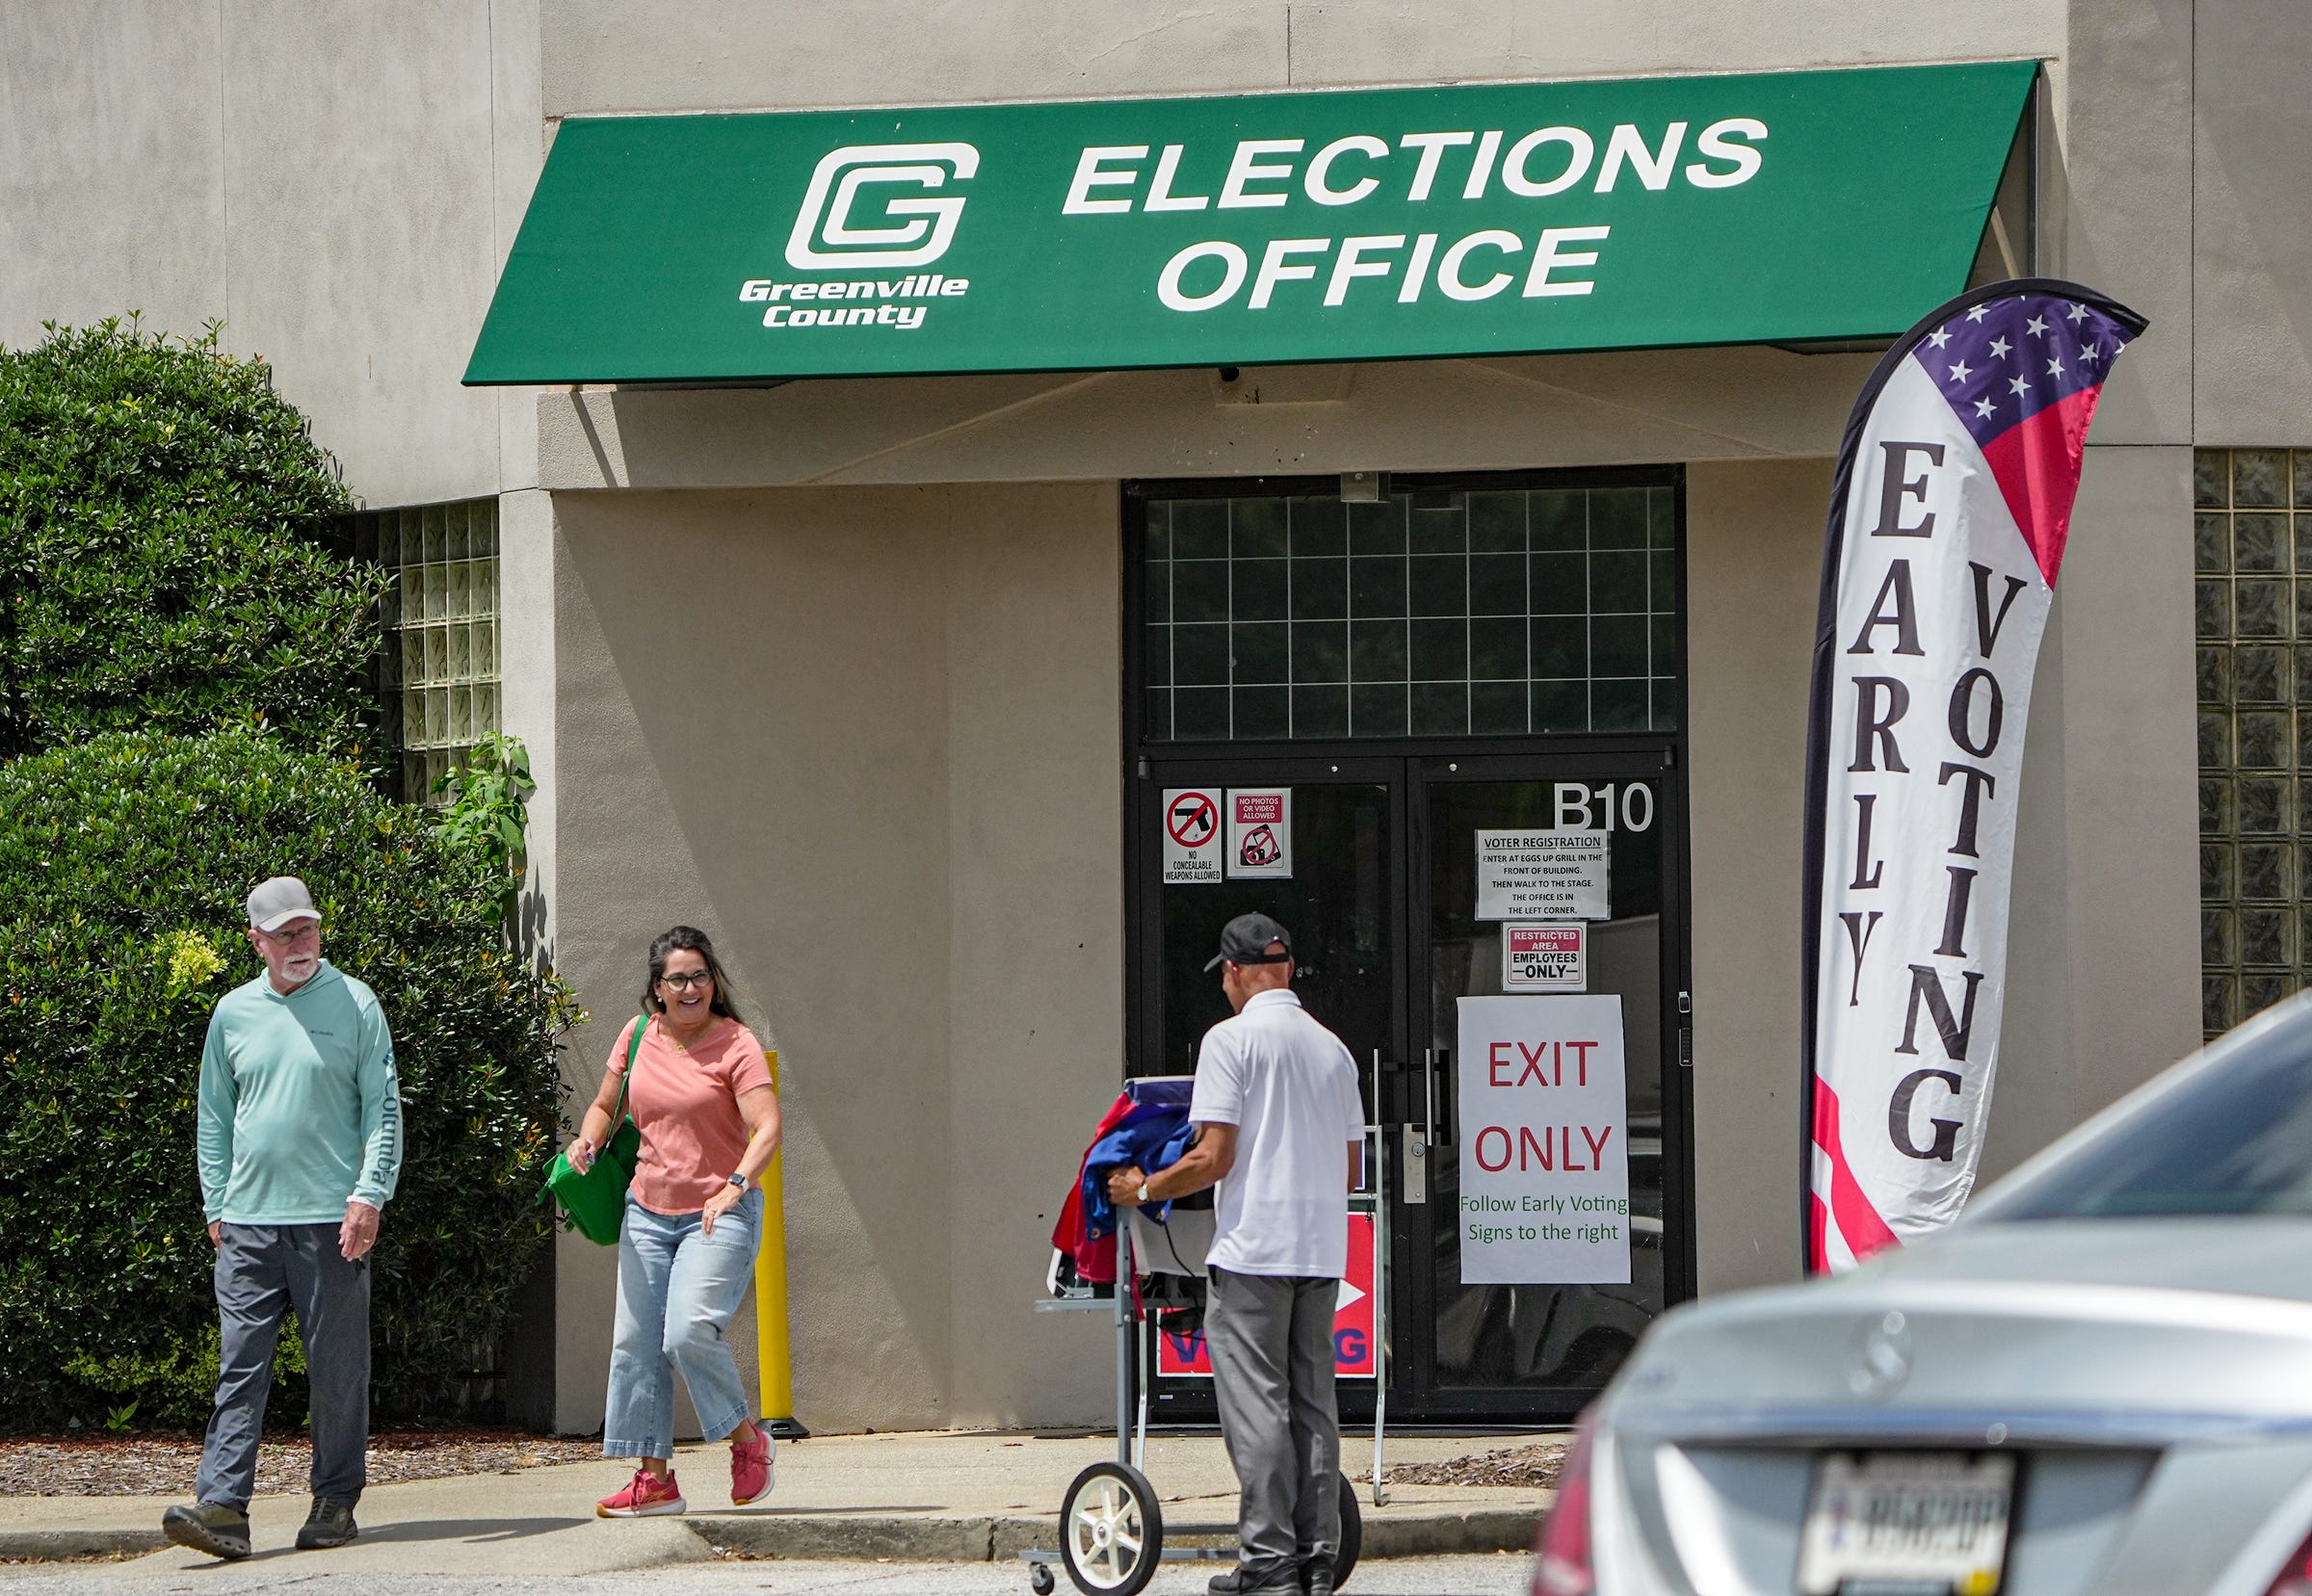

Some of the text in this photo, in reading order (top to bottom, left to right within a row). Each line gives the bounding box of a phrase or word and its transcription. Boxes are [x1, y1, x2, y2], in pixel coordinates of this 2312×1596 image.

[1062, 118, 1769, 215] ELECTIONS
[1157, 225, 1611, 311] OFFICE
[739, 275, 969, 301] Greenville
[762, 304, 927, 329] County
[1839, 440, 1945, 1007] EARLY
[1554, 782, 1654, 832] B10
[1484, 836, 1601, 848] VOTER REGISTRATION
[1173, 861, 1212, 870] CONCEALABLE
[1189, 850, 1196, 859] NO
[1889, 561, 2028, 1162] VOTING
[1166, 871, 1220, 880] WEAPONS ALLOWED
[1514, 931, 1576, 940] RESTRICTED
[1513, 954, 1577, 963] EMPLOYEES
[1525, 965, 1567, 979] ONLY
[1489, 1041, 1598, 1086] EXIT
[1475, 1126, 1612, 1172] ONLY
[1460, 1195, 1628, 1215] Follow Early Voting
[1468, 1223, 1619, 1243] Signs to the right
